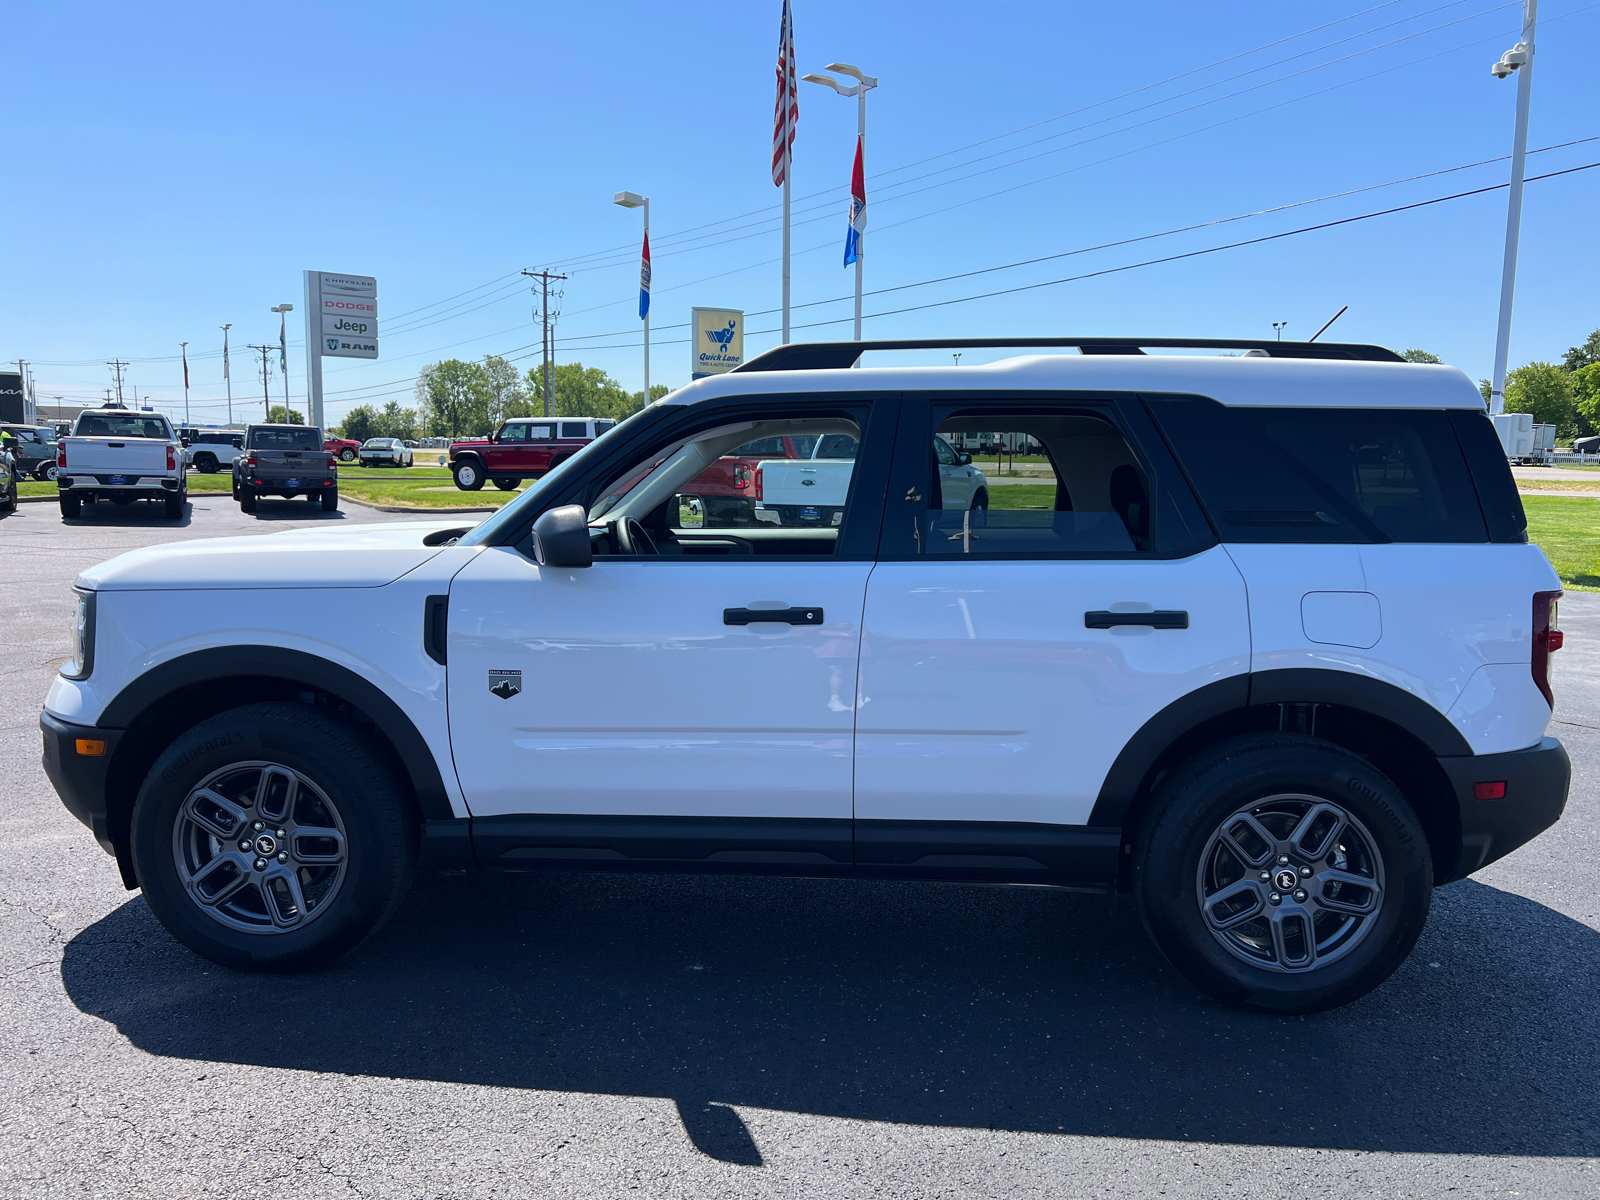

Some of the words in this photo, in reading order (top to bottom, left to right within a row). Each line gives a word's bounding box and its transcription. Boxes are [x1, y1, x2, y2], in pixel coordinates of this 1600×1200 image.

[325, 278, 372, 287] CHRYSLER
[325, 301, 374, 311] DODGE
[334, 319, 367, 334] Jeep
[341, 343, 376, 351] RAM
[699, 353, 722, 361] Quick
[163, 732, 233, 783] Continental
[1348, 777, 1413, 844] Continental
